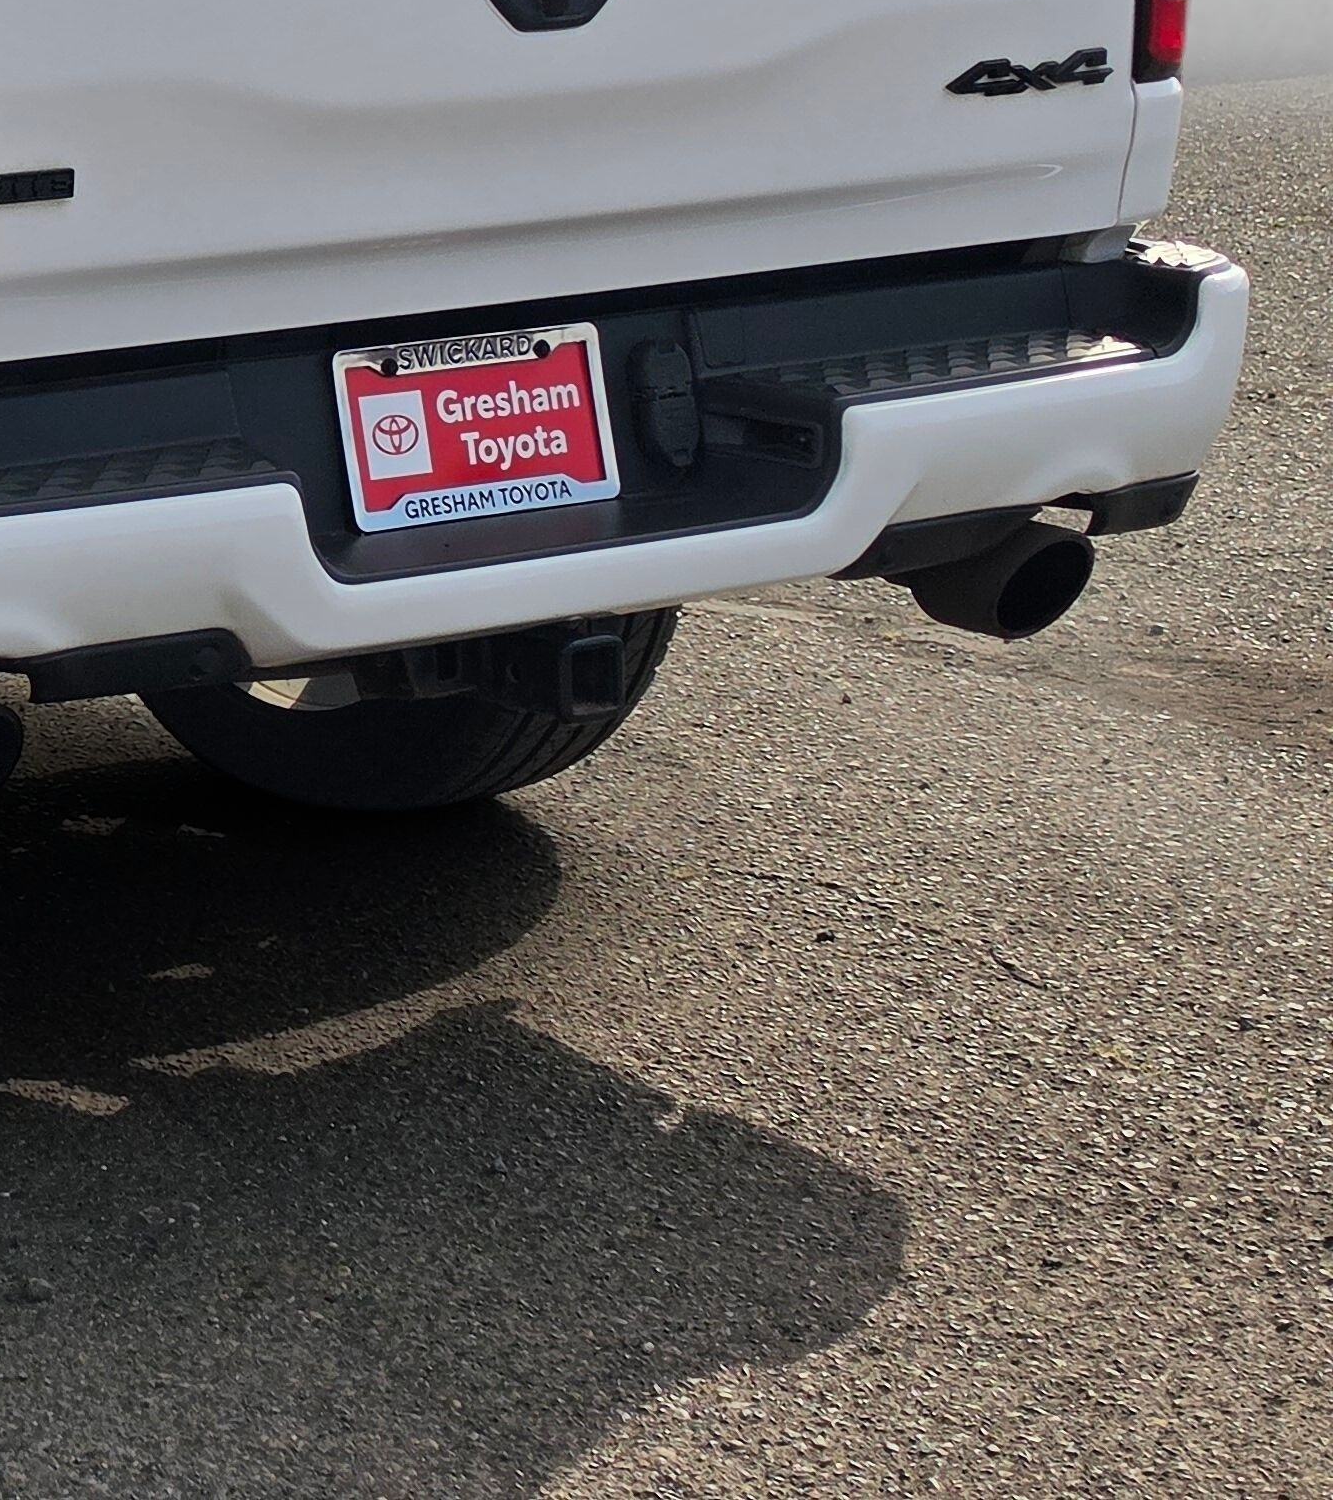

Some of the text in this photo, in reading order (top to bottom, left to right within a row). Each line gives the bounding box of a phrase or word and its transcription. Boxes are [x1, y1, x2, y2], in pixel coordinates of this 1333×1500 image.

[398, 334, 532, 370] SWICKARD
[436, 380, 581, 424] Gresham
[460, 425, 569, 471] Toyota
[404, 480, 573, 519] GRESHAM TOYOTA
